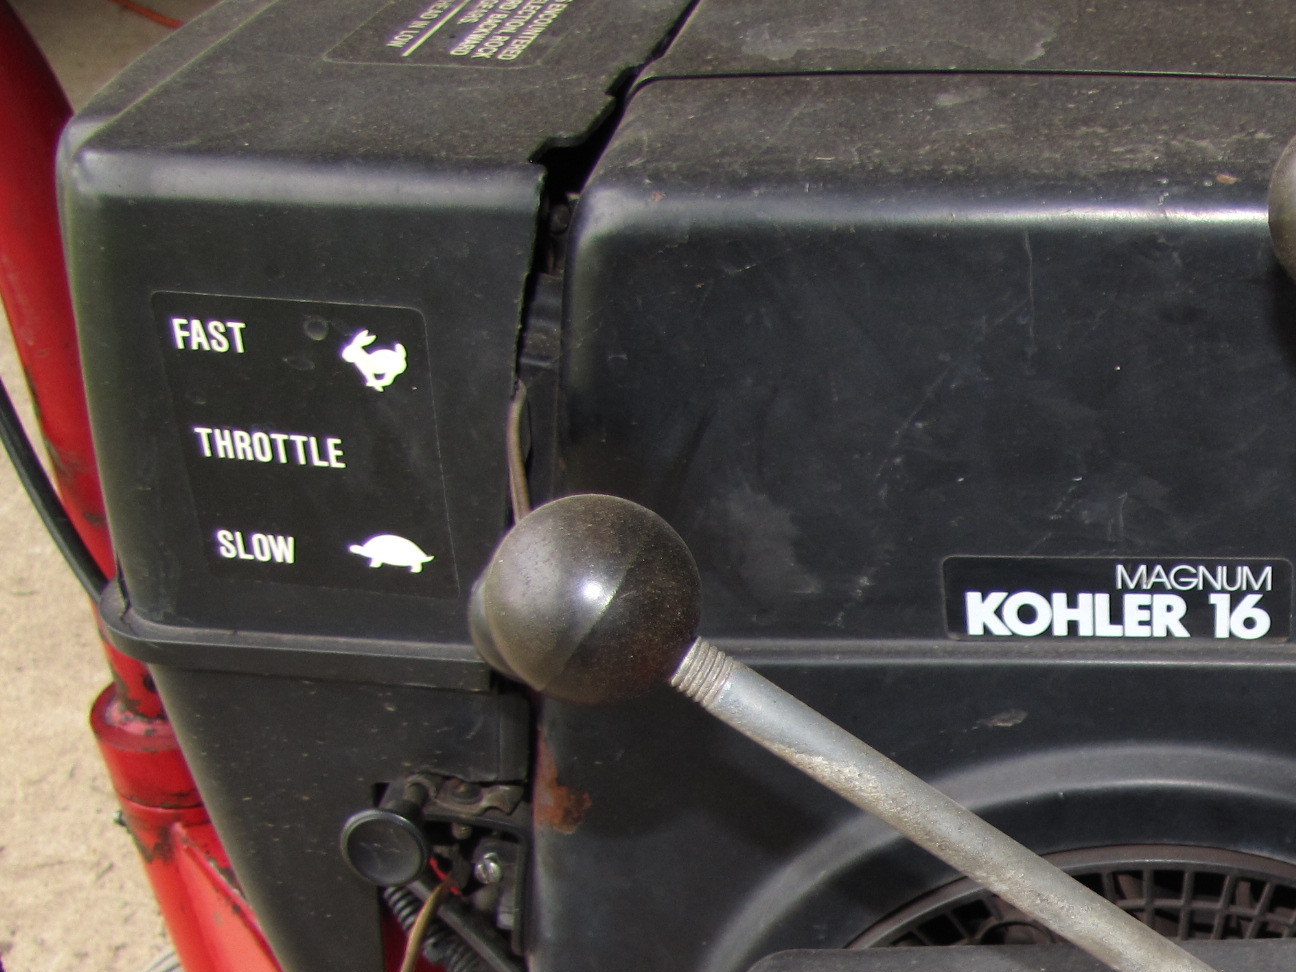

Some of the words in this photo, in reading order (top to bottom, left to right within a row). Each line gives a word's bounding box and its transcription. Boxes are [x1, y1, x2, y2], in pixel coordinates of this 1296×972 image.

[386, 30, 420, 47] LOW
[471, 36, 511, 58] ROCK
[170, 317, 246, 353] FAST
[194, 427, 346, 468] THROTTLE
[216, 529, 295, 564] SLOW
[1116, 564, 1272, 591] MAGNUM
[965, 591, 1191, 638] KOHLER
[1208, 593, 1271, 640] 16
